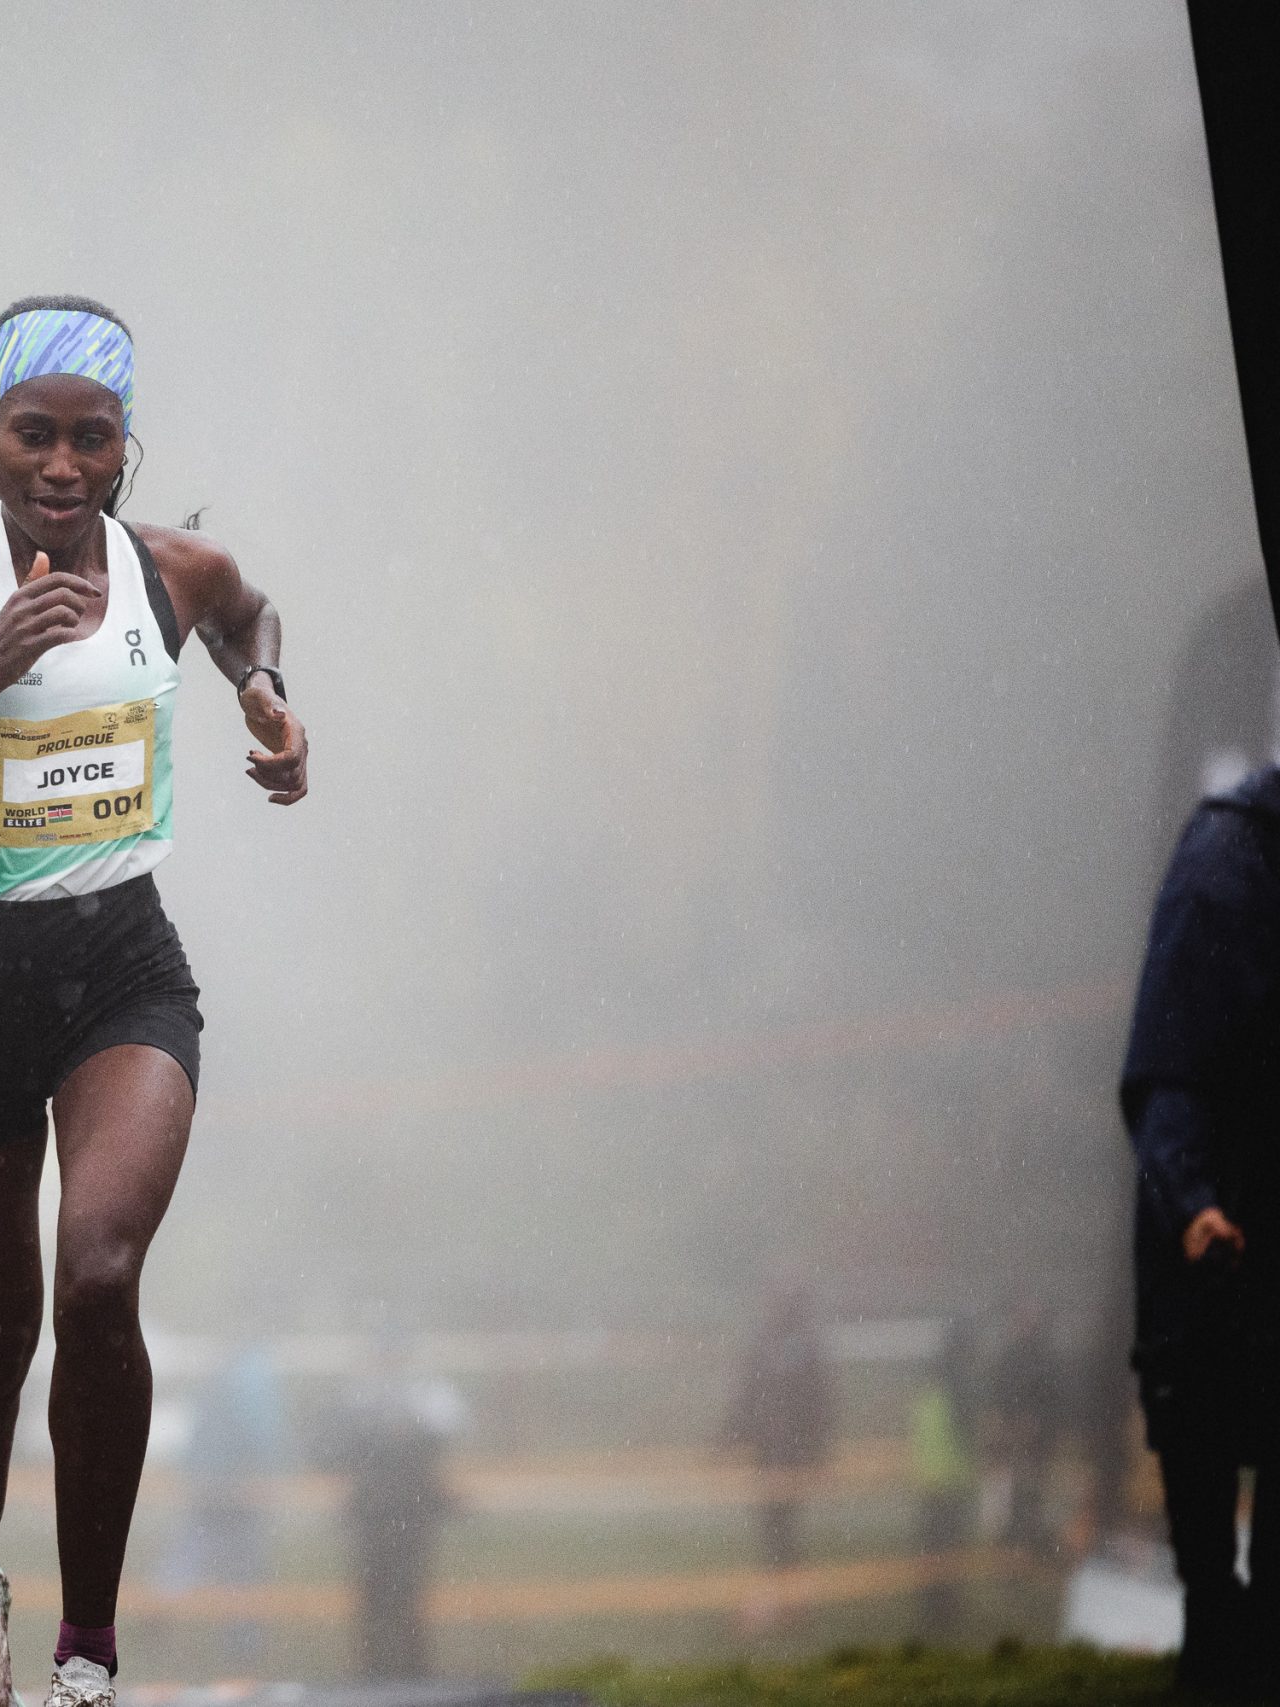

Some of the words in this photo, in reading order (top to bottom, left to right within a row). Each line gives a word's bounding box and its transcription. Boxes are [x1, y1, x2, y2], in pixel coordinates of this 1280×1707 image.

[36, 732, 114, 755] PROLOGUE
[37, 761, 115, 789] JOYCE
[5, 807, 46, 817] WORLD
[93, 791, 142, 819] 001
[6, 818, 43, 827] ELITE
